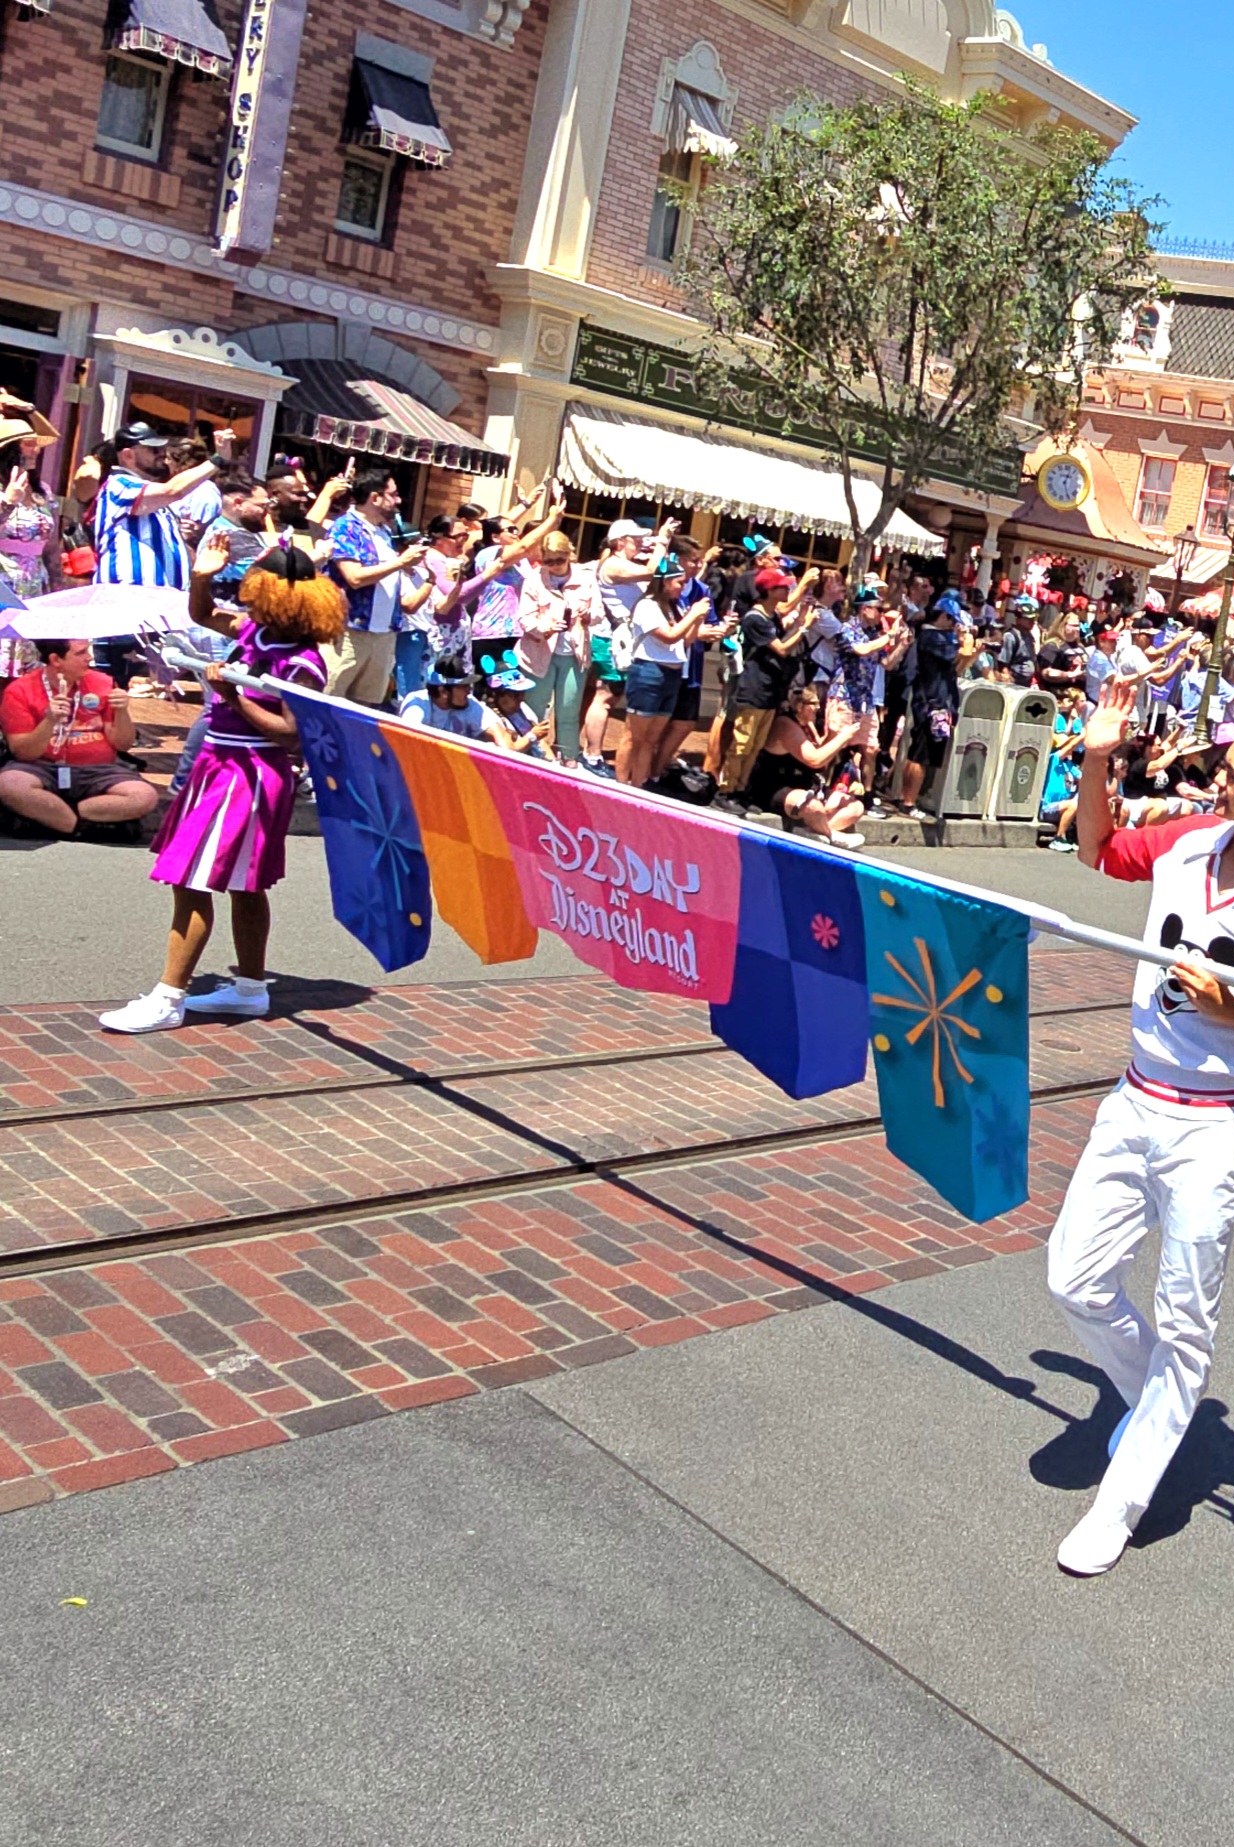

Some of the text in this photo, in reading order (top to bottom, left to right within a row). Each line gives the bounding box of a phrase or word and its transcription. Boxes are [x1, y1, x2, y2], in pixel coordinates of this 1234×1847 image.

[223, 92, 253, 213] SHOP
[594, 344, 629, 360] GIFTS
[579, 356, 637, 377] JEWELRY
[609, 887, 630, 910] AT
[538, 867, 700, 981] Disneyland
